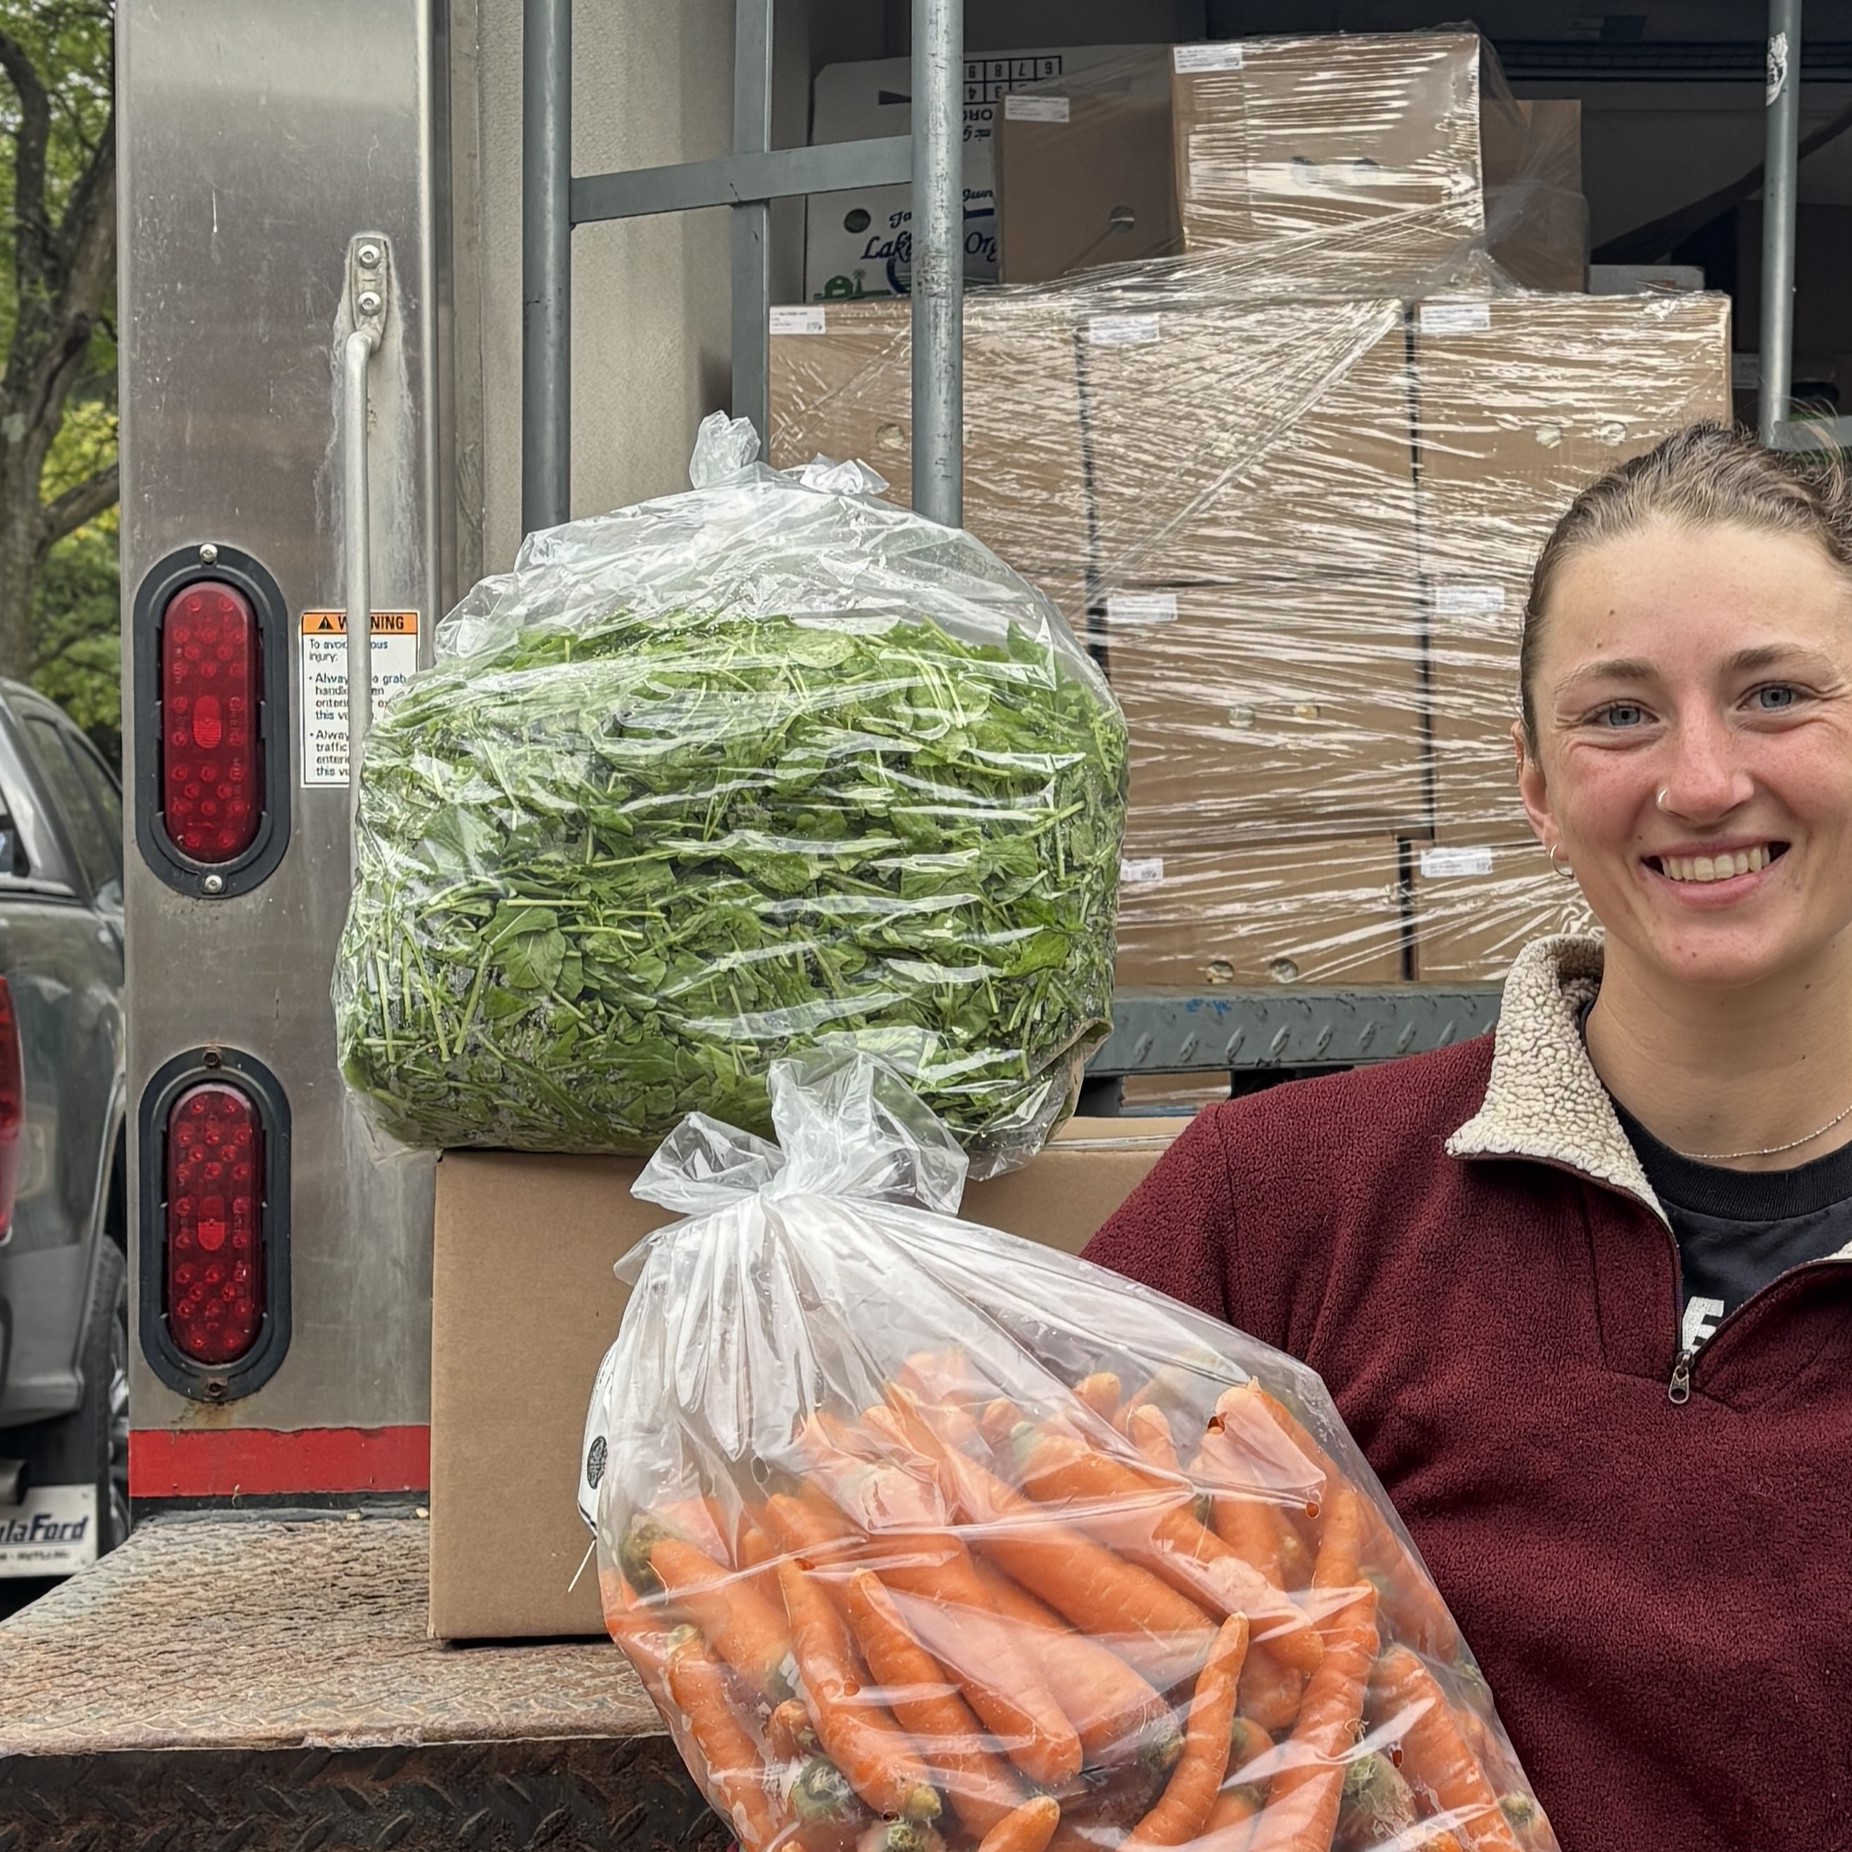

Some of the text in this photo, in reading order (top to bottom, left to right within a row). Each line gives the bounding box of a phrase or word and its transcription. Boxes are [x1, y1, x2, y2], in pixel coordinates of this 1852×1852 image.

[338, 615, 404, 630] WNING
[309, 639, 320, 649] To
[315, 709, 335, 720] this
[316, 742, 348, 752] traffic
[316, 766, 335, 776] this
